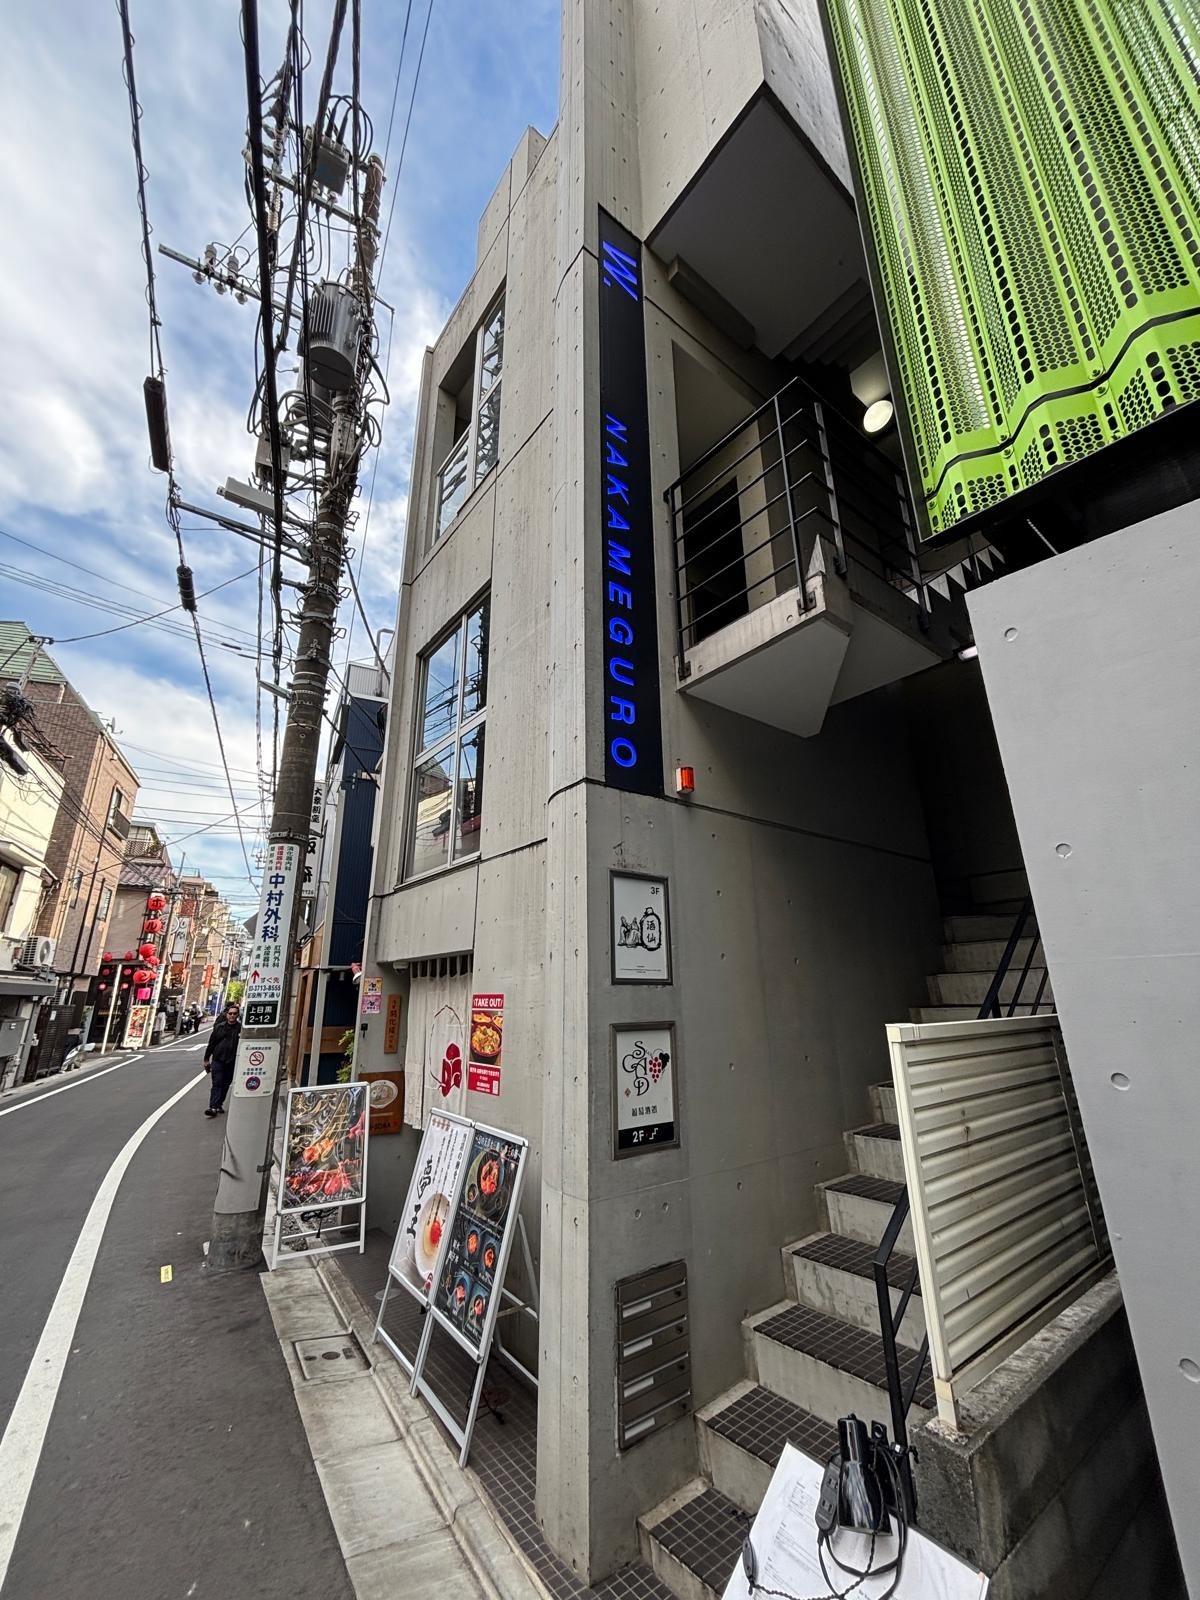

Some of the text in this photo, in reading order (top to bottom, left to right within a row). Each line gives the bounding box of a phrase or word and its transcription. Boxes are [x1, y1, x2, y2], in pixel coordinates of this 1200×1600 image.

[606, 414, 637, 768] NAKAMEGURO
[650, 886, 660, 896] 3F
[261, 872, 286, 943] 中村外科
[646, 919, 657, 943] 酒仙
[475, 997, 501, 1008] TAKE OUT
[249, 1005, 273, 1014] 上目黒
[249, 1015, 270, 1023] 2-12
[632, 1131, 645, 1144] 2F
